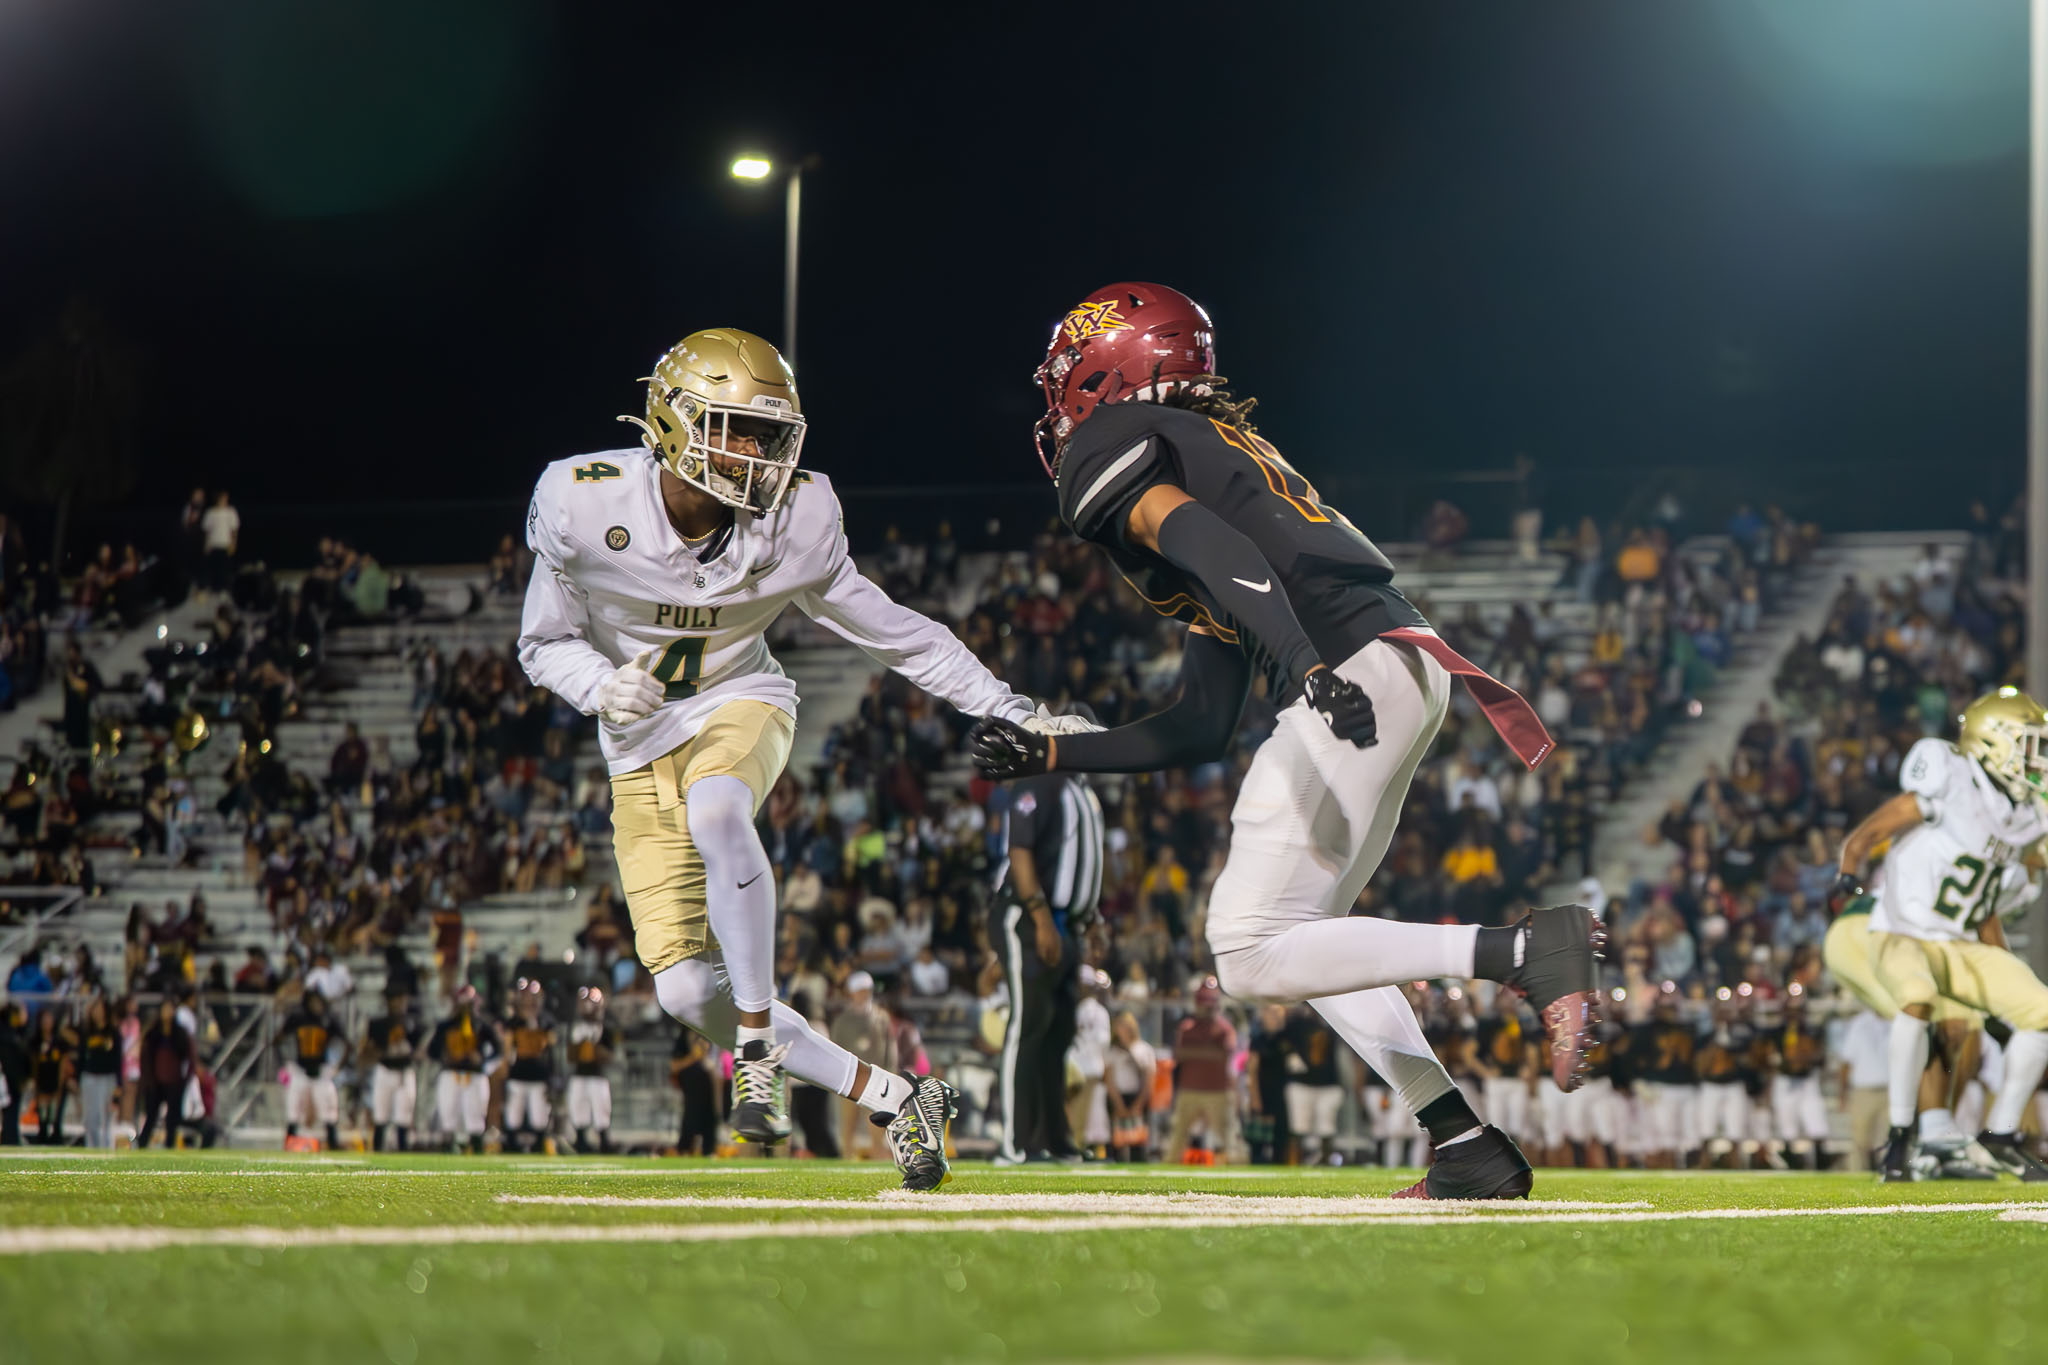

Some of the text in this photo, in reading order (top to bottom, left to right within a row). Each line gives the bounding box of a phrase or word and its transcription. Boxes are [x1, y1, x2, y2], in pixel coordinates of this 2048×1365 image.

[1066, 300, 1118, 342] W
[1193, 330, 1206, 348] 11
[572, 461, 624, 485] 4
[654, 603, 723, 629] POLY
[649, 635, 711, 704] 4
